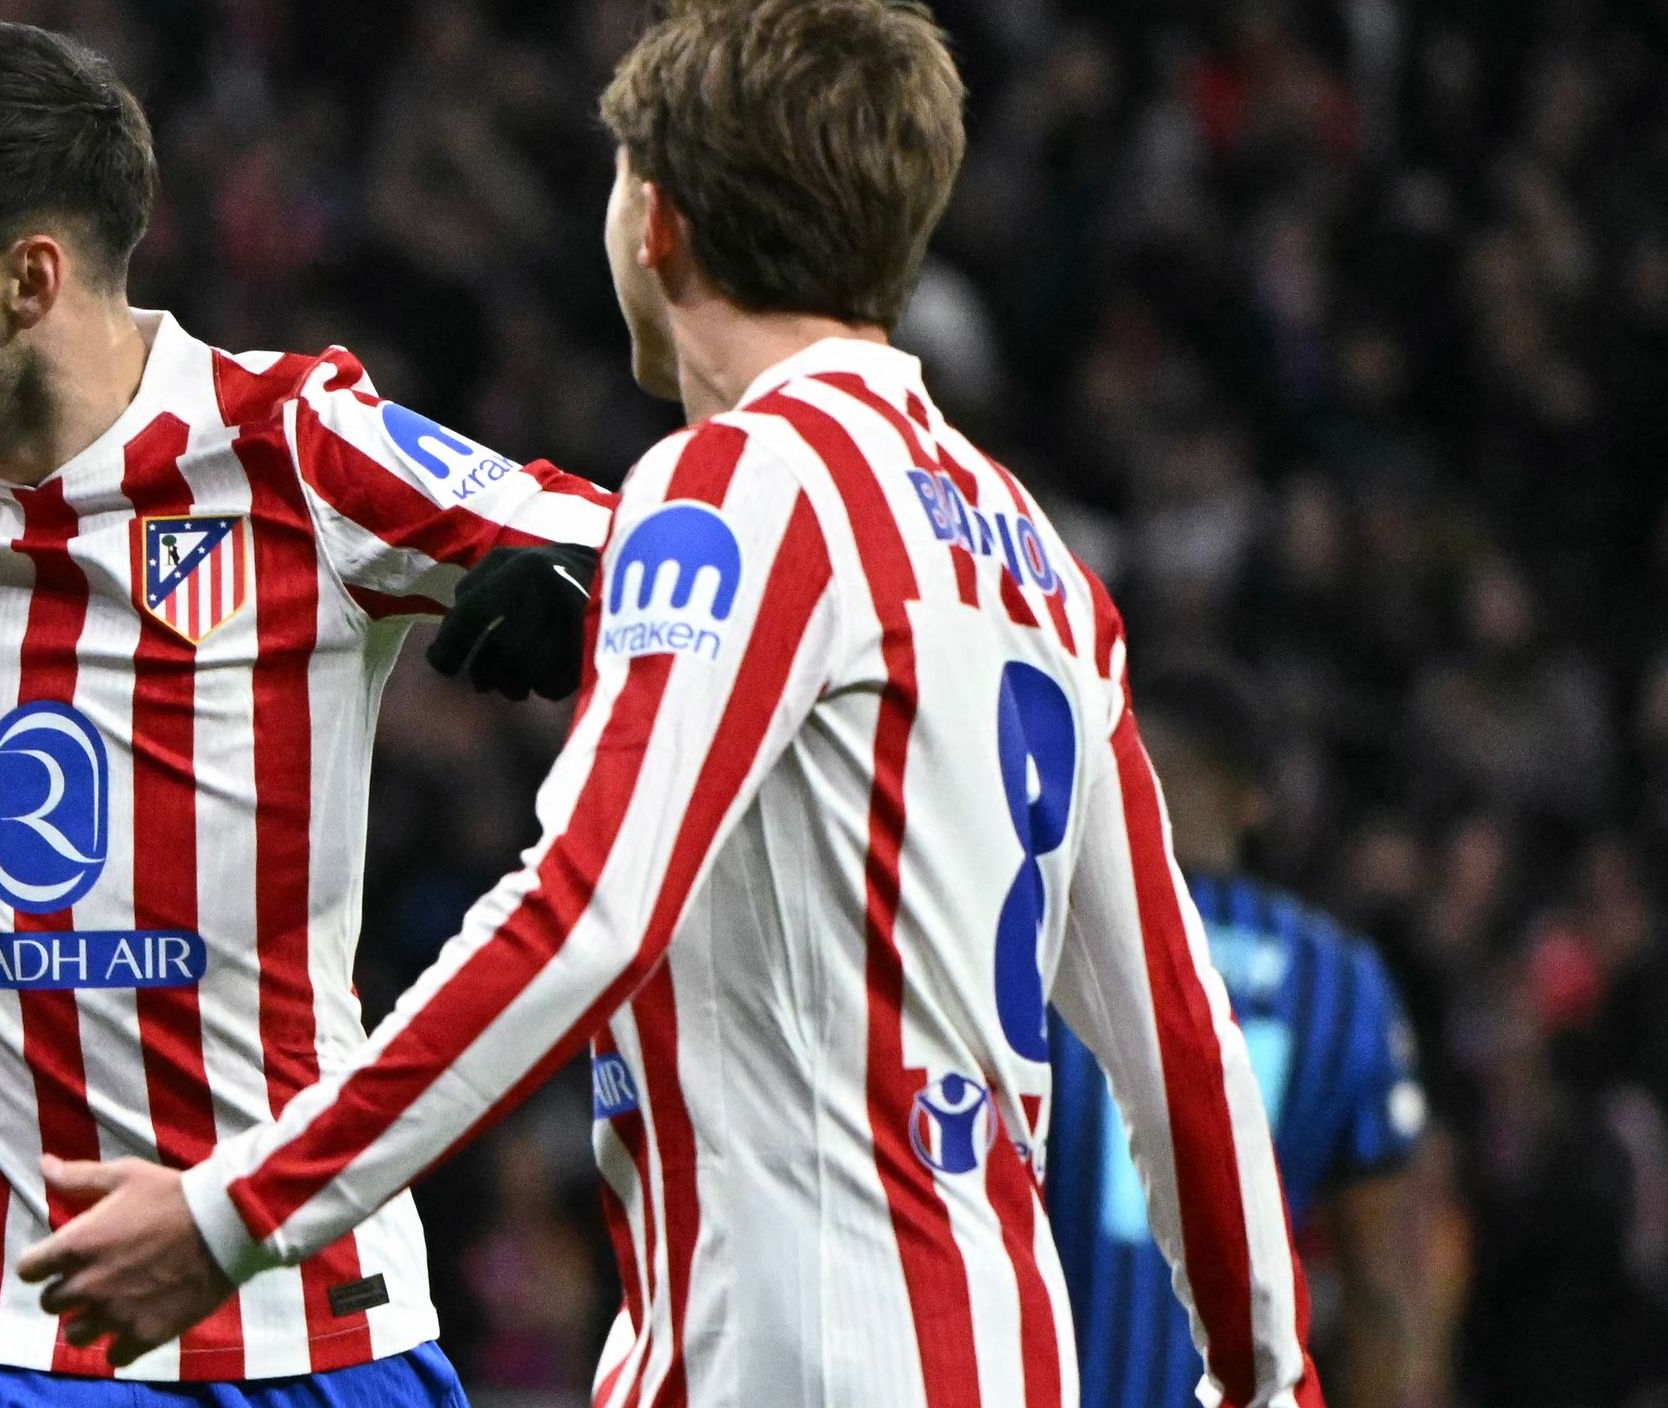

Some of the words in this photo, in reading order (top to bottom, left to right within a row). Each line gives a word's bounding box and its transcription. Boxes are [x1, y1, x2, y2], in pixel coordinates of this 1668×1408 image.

[452, 454, 514, 500] kra
[603, 621, 721, 661] kraken
[994, 661, 1076, 1062] 8
[105, 937, 193, 979] AIR
